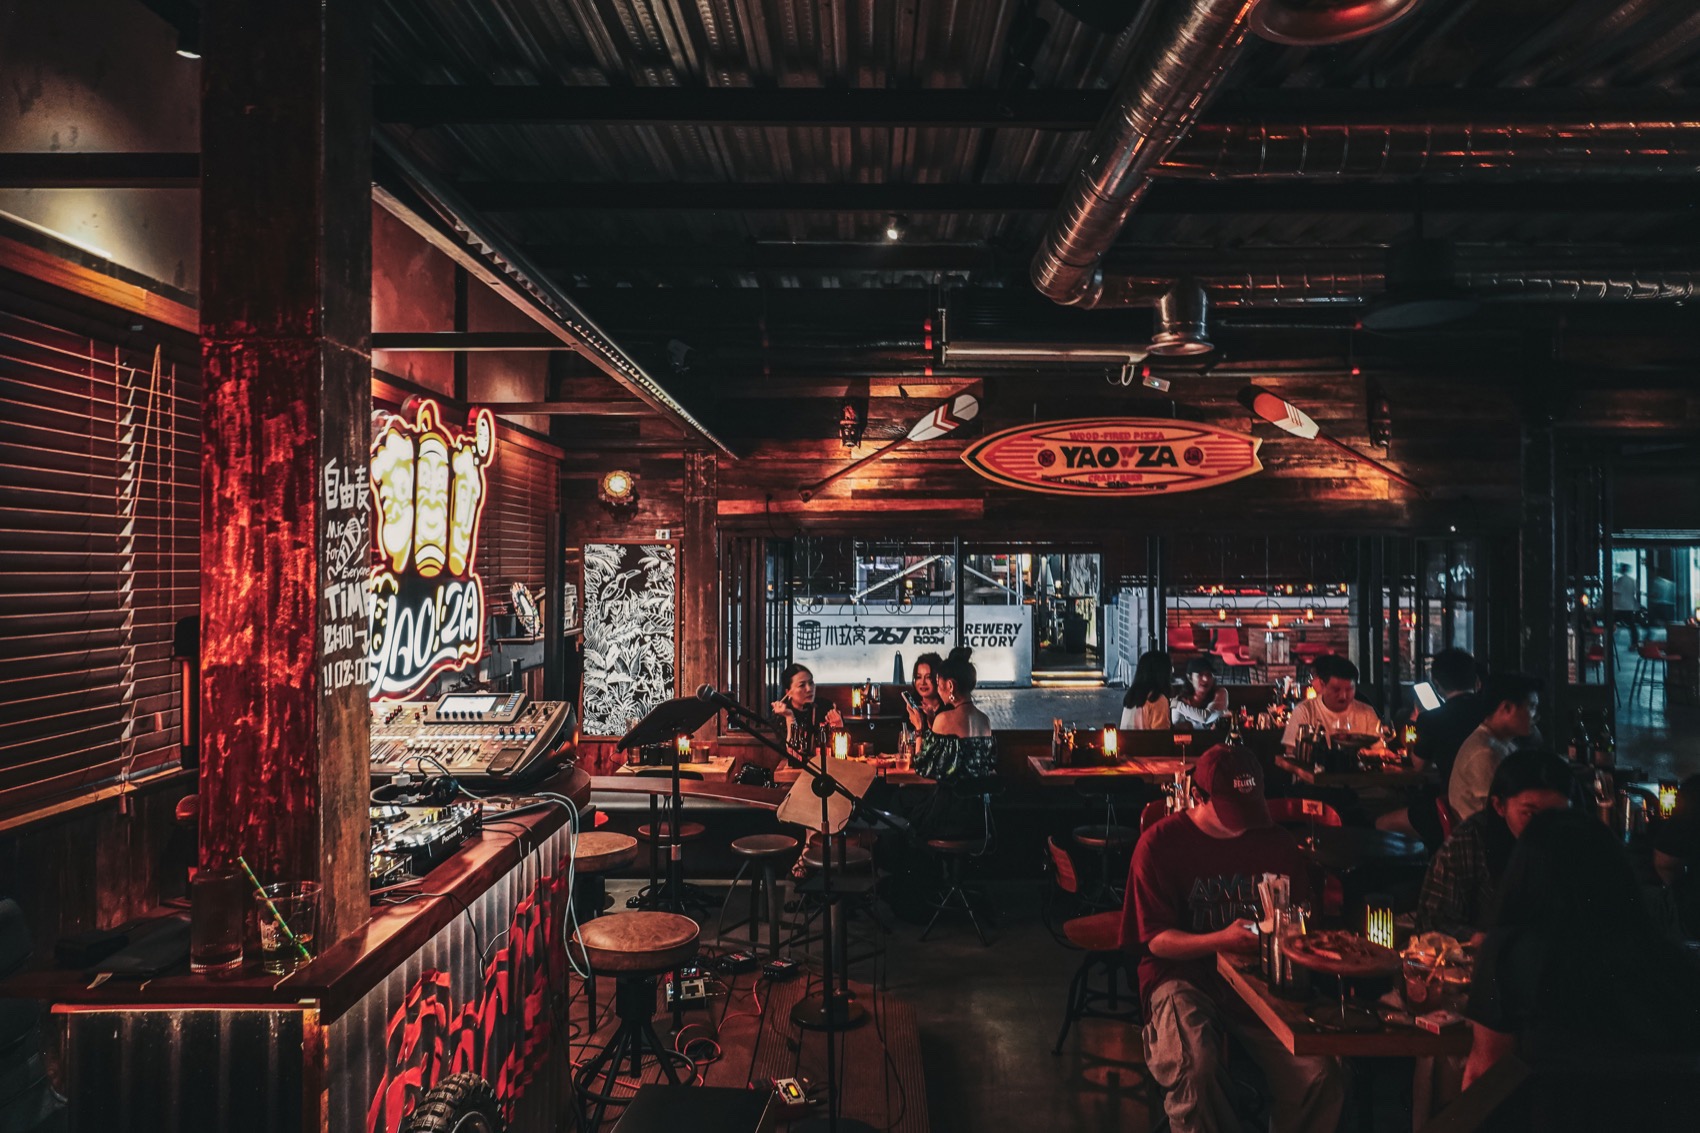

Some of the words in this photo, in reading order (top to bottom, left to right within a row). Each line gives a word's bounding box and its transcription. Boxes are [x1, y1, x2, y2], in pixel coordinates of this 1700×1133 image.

[1133, 431, 1165, 441] PIZZA
[1088, 474, 1117, 482] CRAFT
[326, 520, 344, 538] Mic
[326, 542, 339, 563] for
[341, 566, 370, 582] Everyone
[913, 626, 939, 635] TAP
[964, 623, 1023, 634] REWERY
[868, 626, 912, 645] 267
[913, 635, 945, 645] ROOM
[963, 635, 1017, 647] ACTORY
